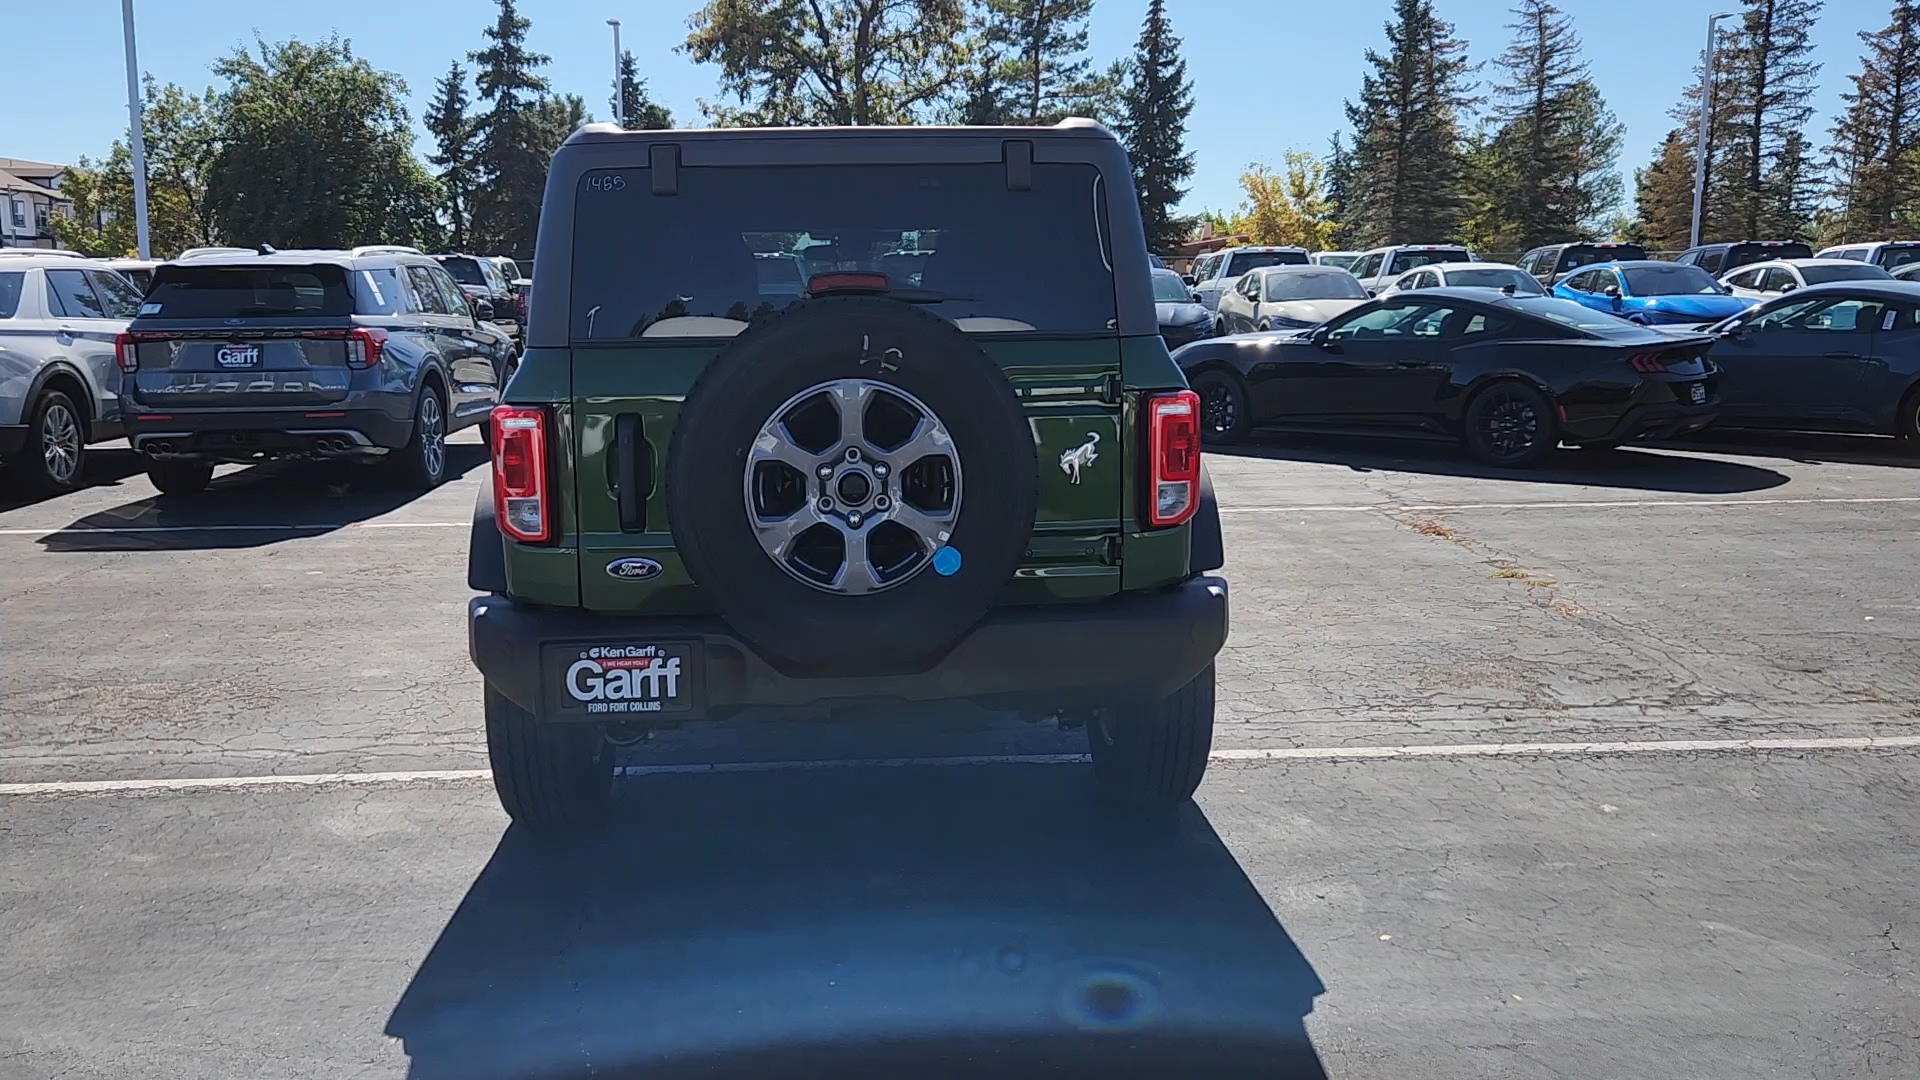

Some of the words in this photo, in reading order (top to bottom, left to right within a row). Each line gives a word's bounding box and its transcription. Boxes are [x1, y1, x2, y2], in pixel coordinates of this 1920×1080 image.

[217, 348, 259, 364] Garff
[600, 646, 624, 658] Ken
[625, 645, 656, 657] Garff
[566, 657, 681, 701] Garff
[588, 702, 608, 712] FORD
[609, 702, 629, 712] FORT
[630, 701, 661, 711] COLLINS
